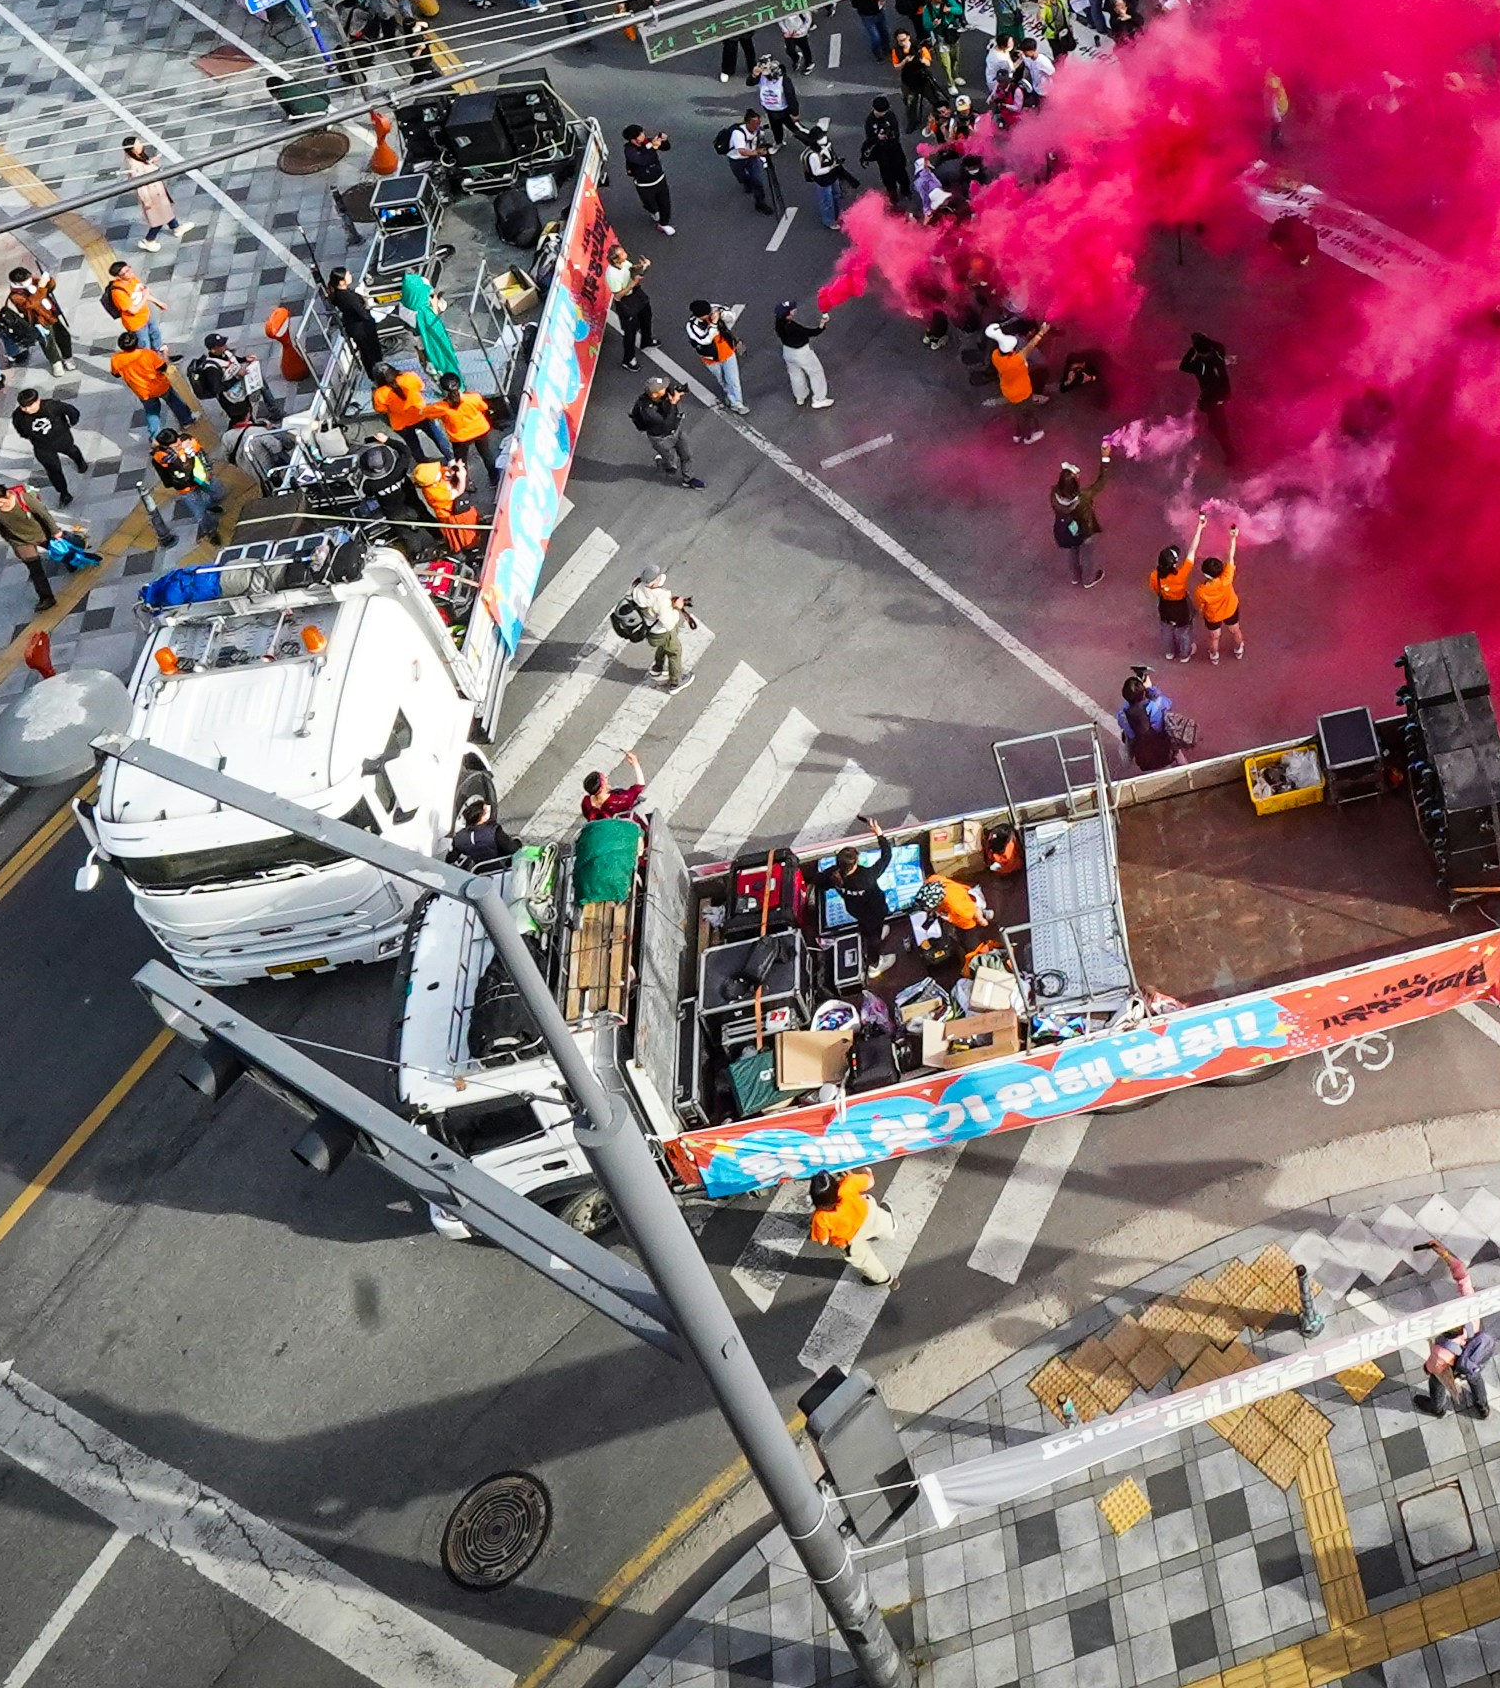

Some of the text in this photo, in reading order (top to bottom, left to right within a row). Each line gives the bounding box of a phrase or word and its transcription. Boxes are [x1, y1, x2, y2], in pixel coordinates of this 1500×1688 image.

[738, 1011, 1262, 1187] 함께 살기 위해 멈춰!
